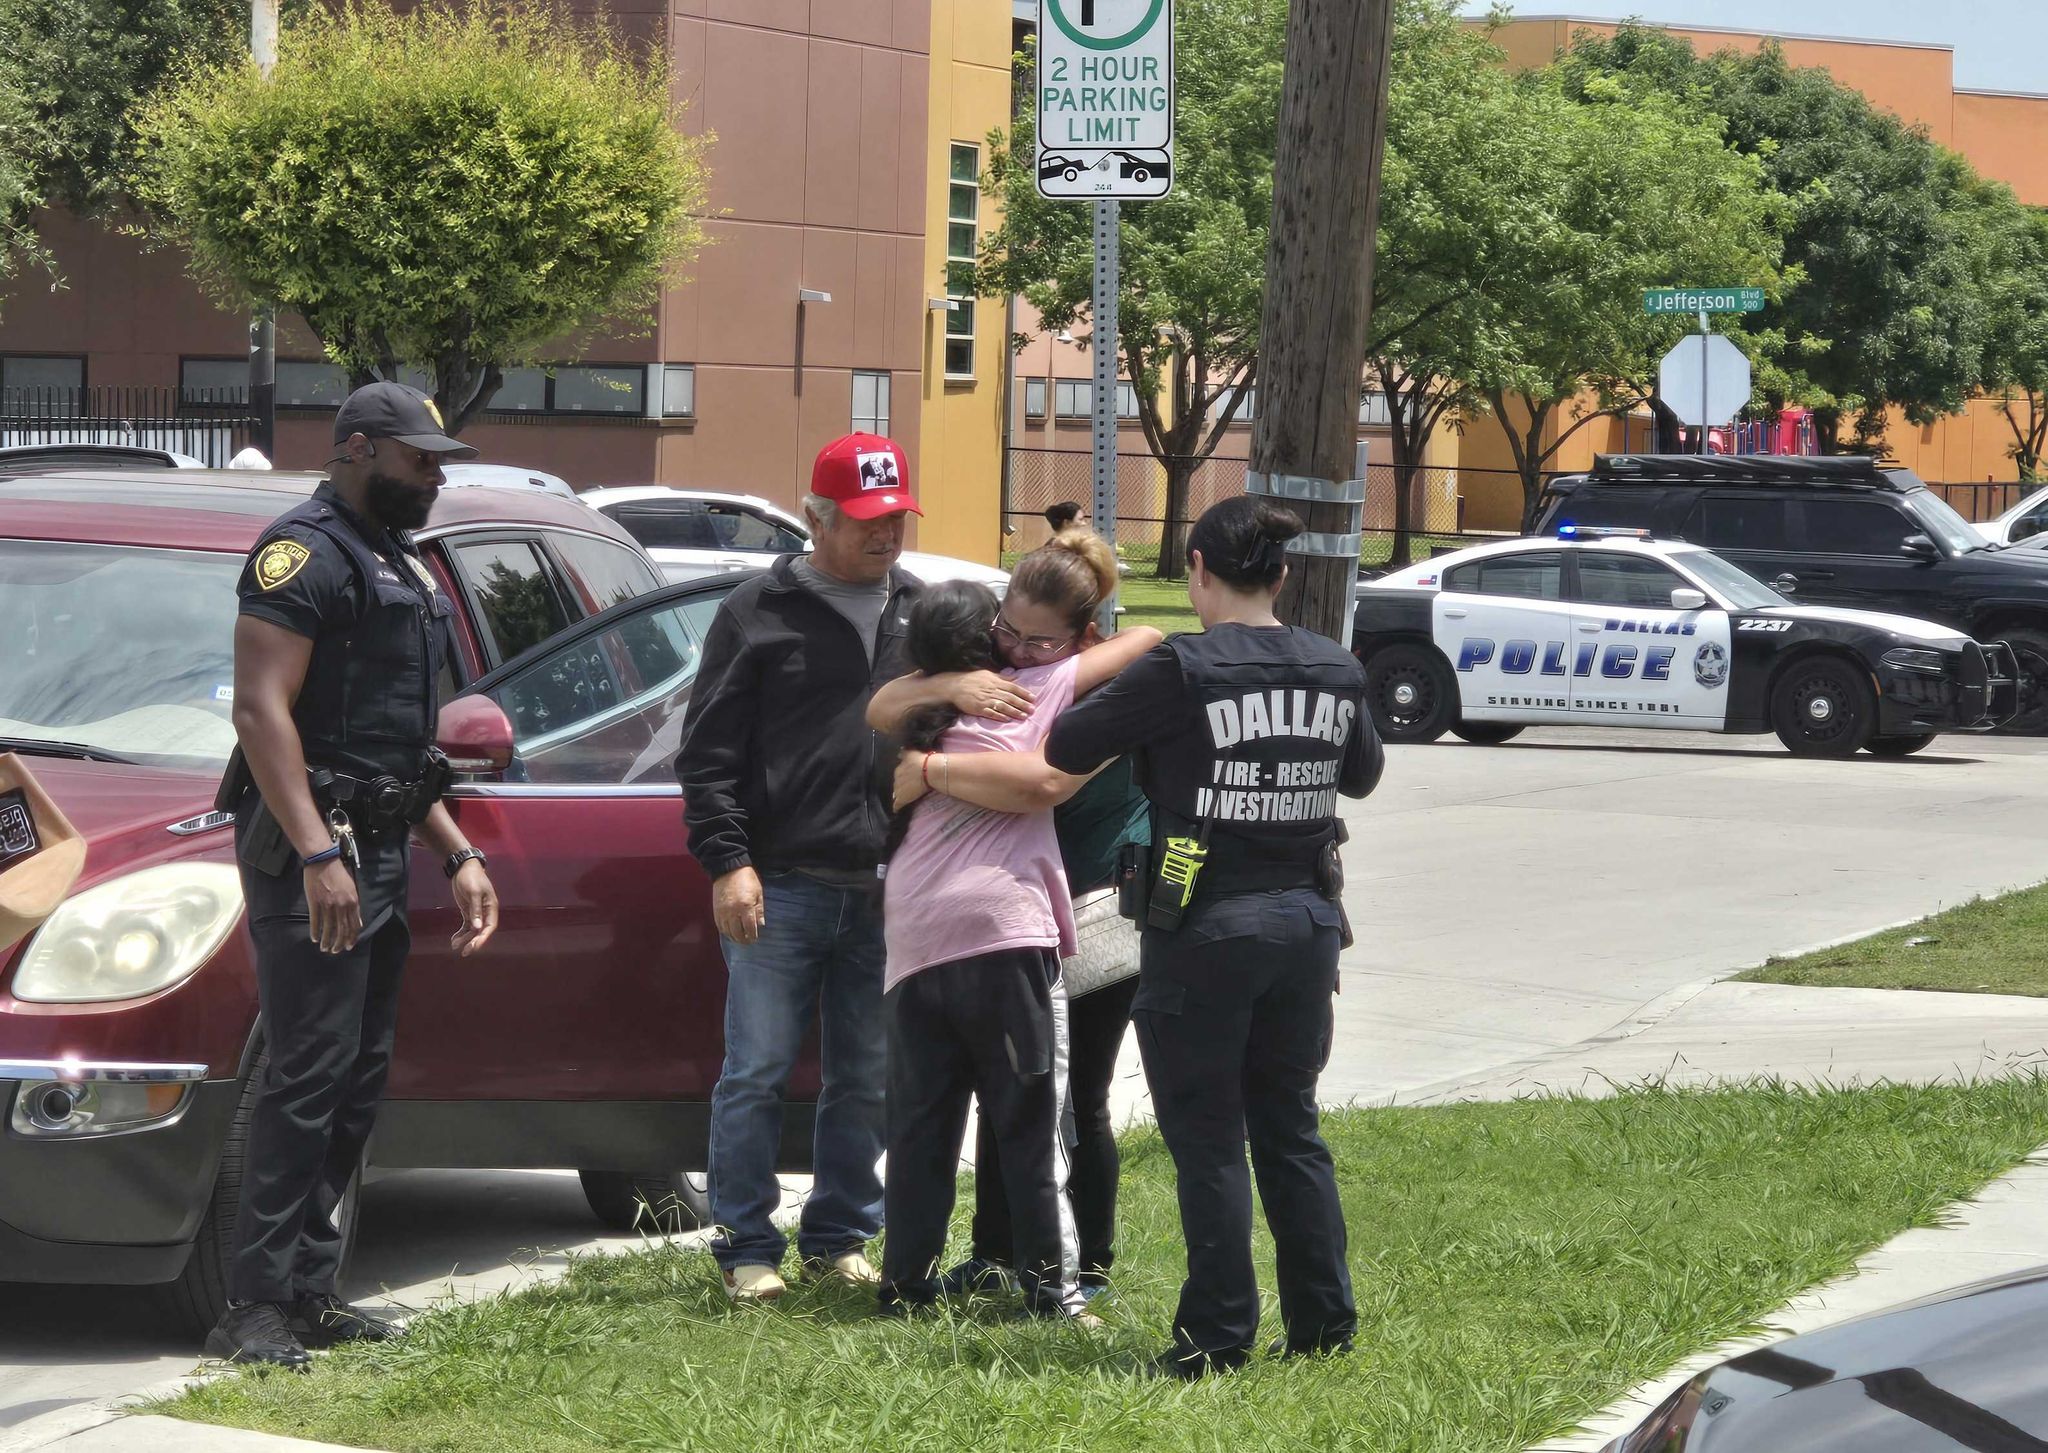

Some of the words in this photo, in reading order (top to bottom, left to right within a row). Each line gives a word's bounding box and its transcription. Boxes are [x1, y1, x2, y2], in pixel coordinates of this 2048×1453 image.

[1051, 57, 1067, 81] 2
[1081, 57, 1158, 81] HOUR
[1043, 87, 1166, 112] PARKING
[1068, 117, 1141, 142] LIMIT
[1655, 292, 1735, 310] Jefferson
[1741, 290, 1760, 299] Blvd
[1604, 618, 1697, 636] DALLAS
[1738, 619, 1794, 632] 2237
[1456, 637, 1676, 681] POLICE
[1488, 696, 1566, 707] SERVING
[1575, 699, 1628, 710] SINCE
[1206, 689, 1356, 749] DALLAS
[1276, 759, 1339, 787] RESCUE
